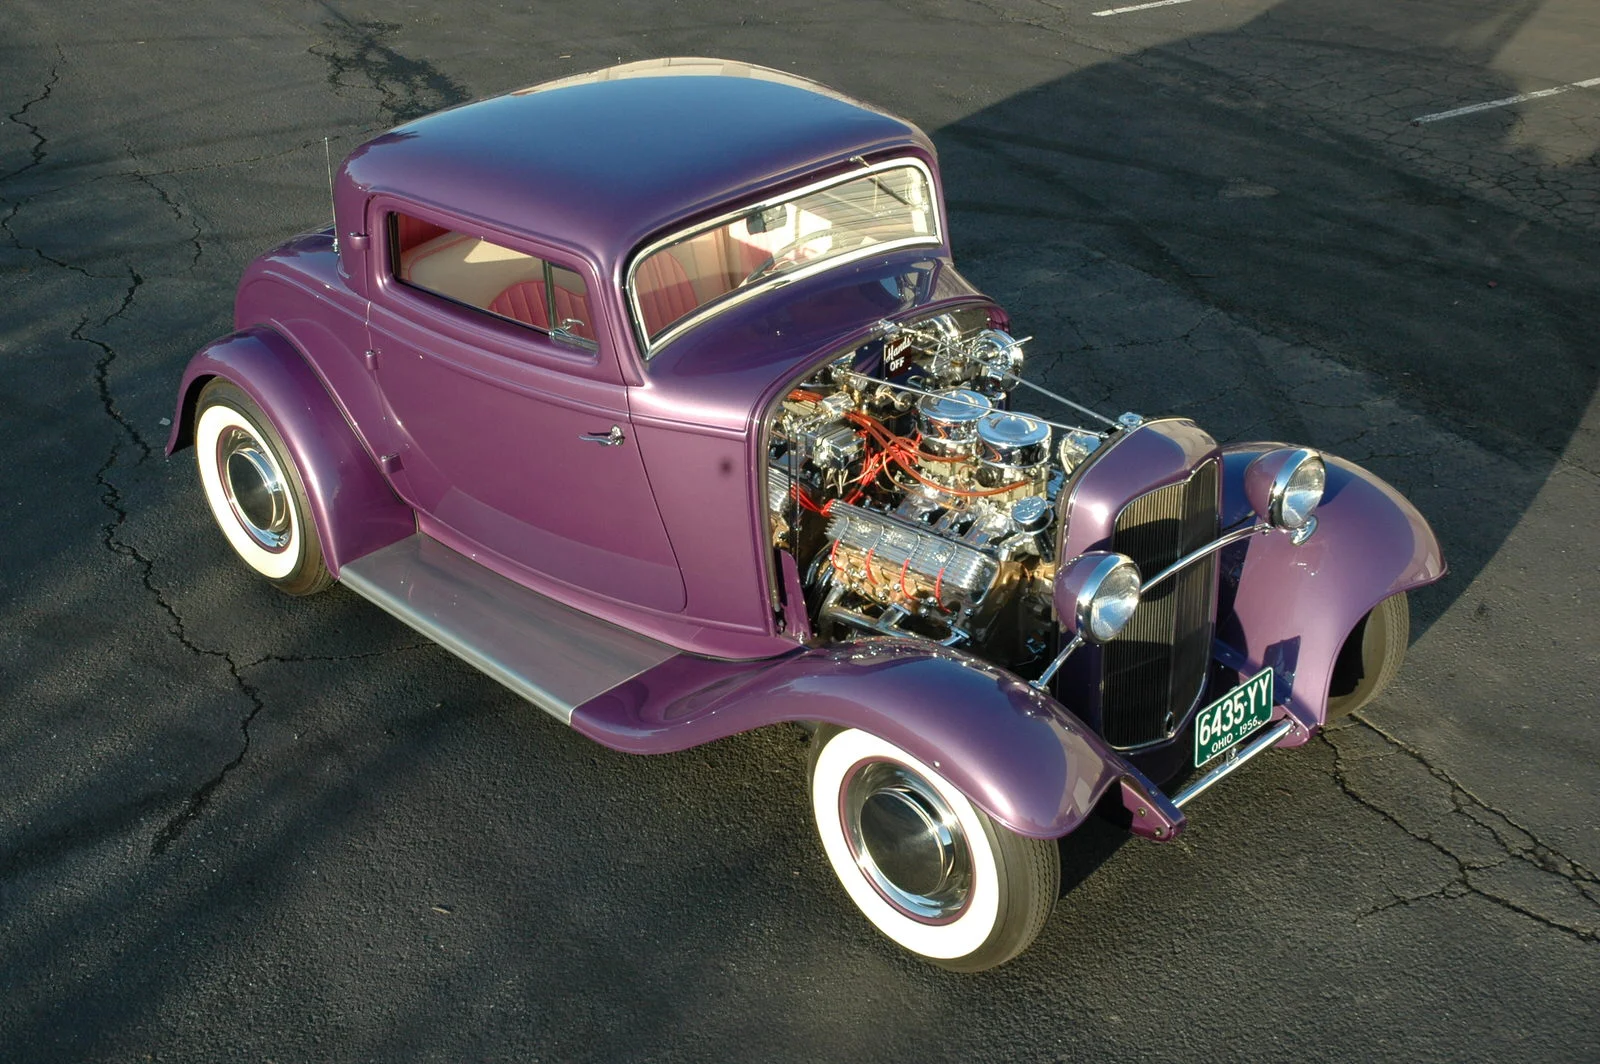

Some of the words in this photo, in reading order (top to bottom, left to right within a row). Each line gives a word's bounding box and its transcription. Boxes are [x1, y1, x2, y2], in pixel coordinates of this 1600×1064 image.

[890, 356, 905, 371] OFF
[1211, 732, 1234, 753] OHIO
[1239, 715, 1258, 736] 1956
